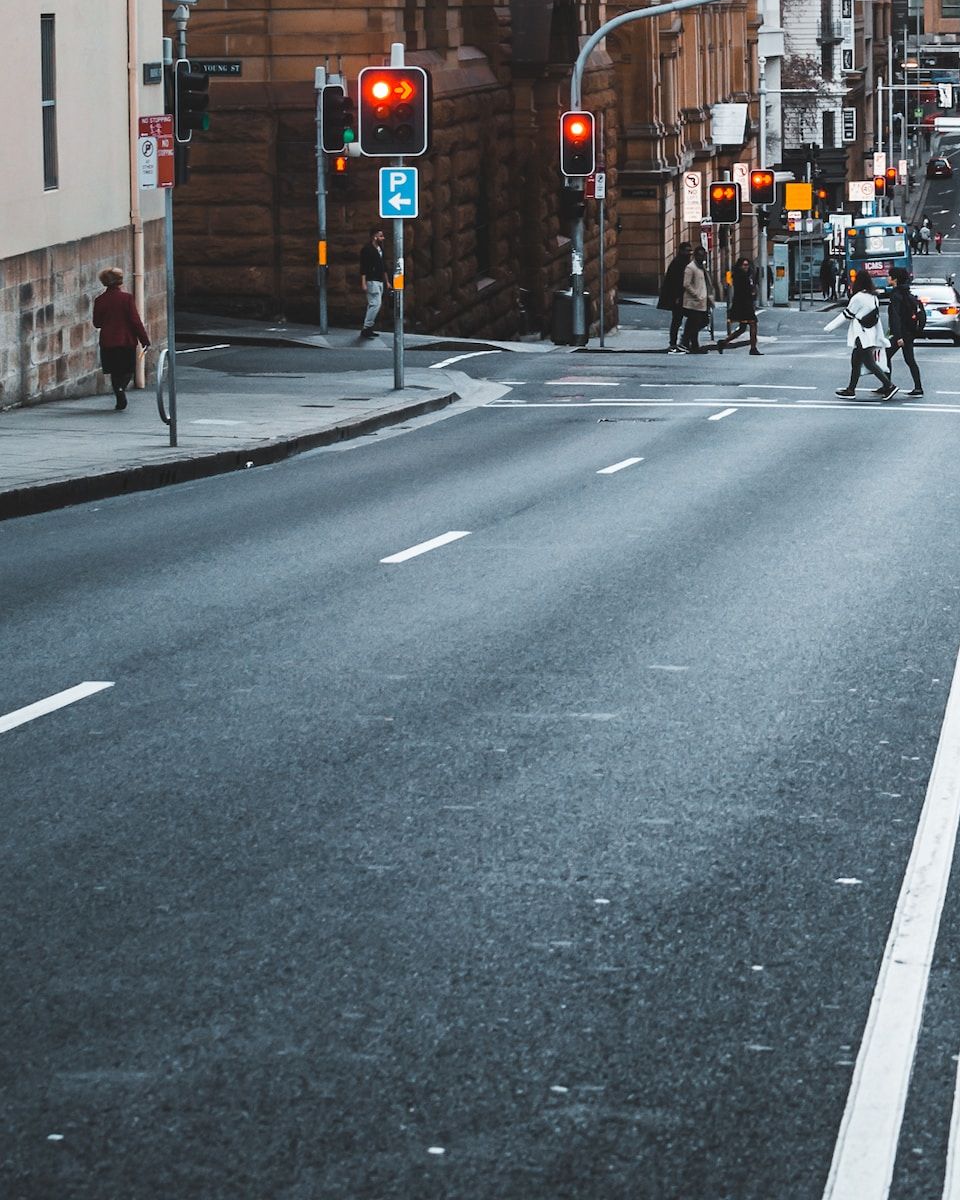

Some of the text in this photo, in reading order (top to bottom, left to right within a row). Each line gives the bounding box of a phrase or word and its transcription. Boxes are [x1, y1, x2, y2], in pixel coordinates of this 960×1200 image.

[203, 64, 240, 72] YOUNG ST
[389, 172, 407, 192] P
[864, 261, 883, 270] ICMS
